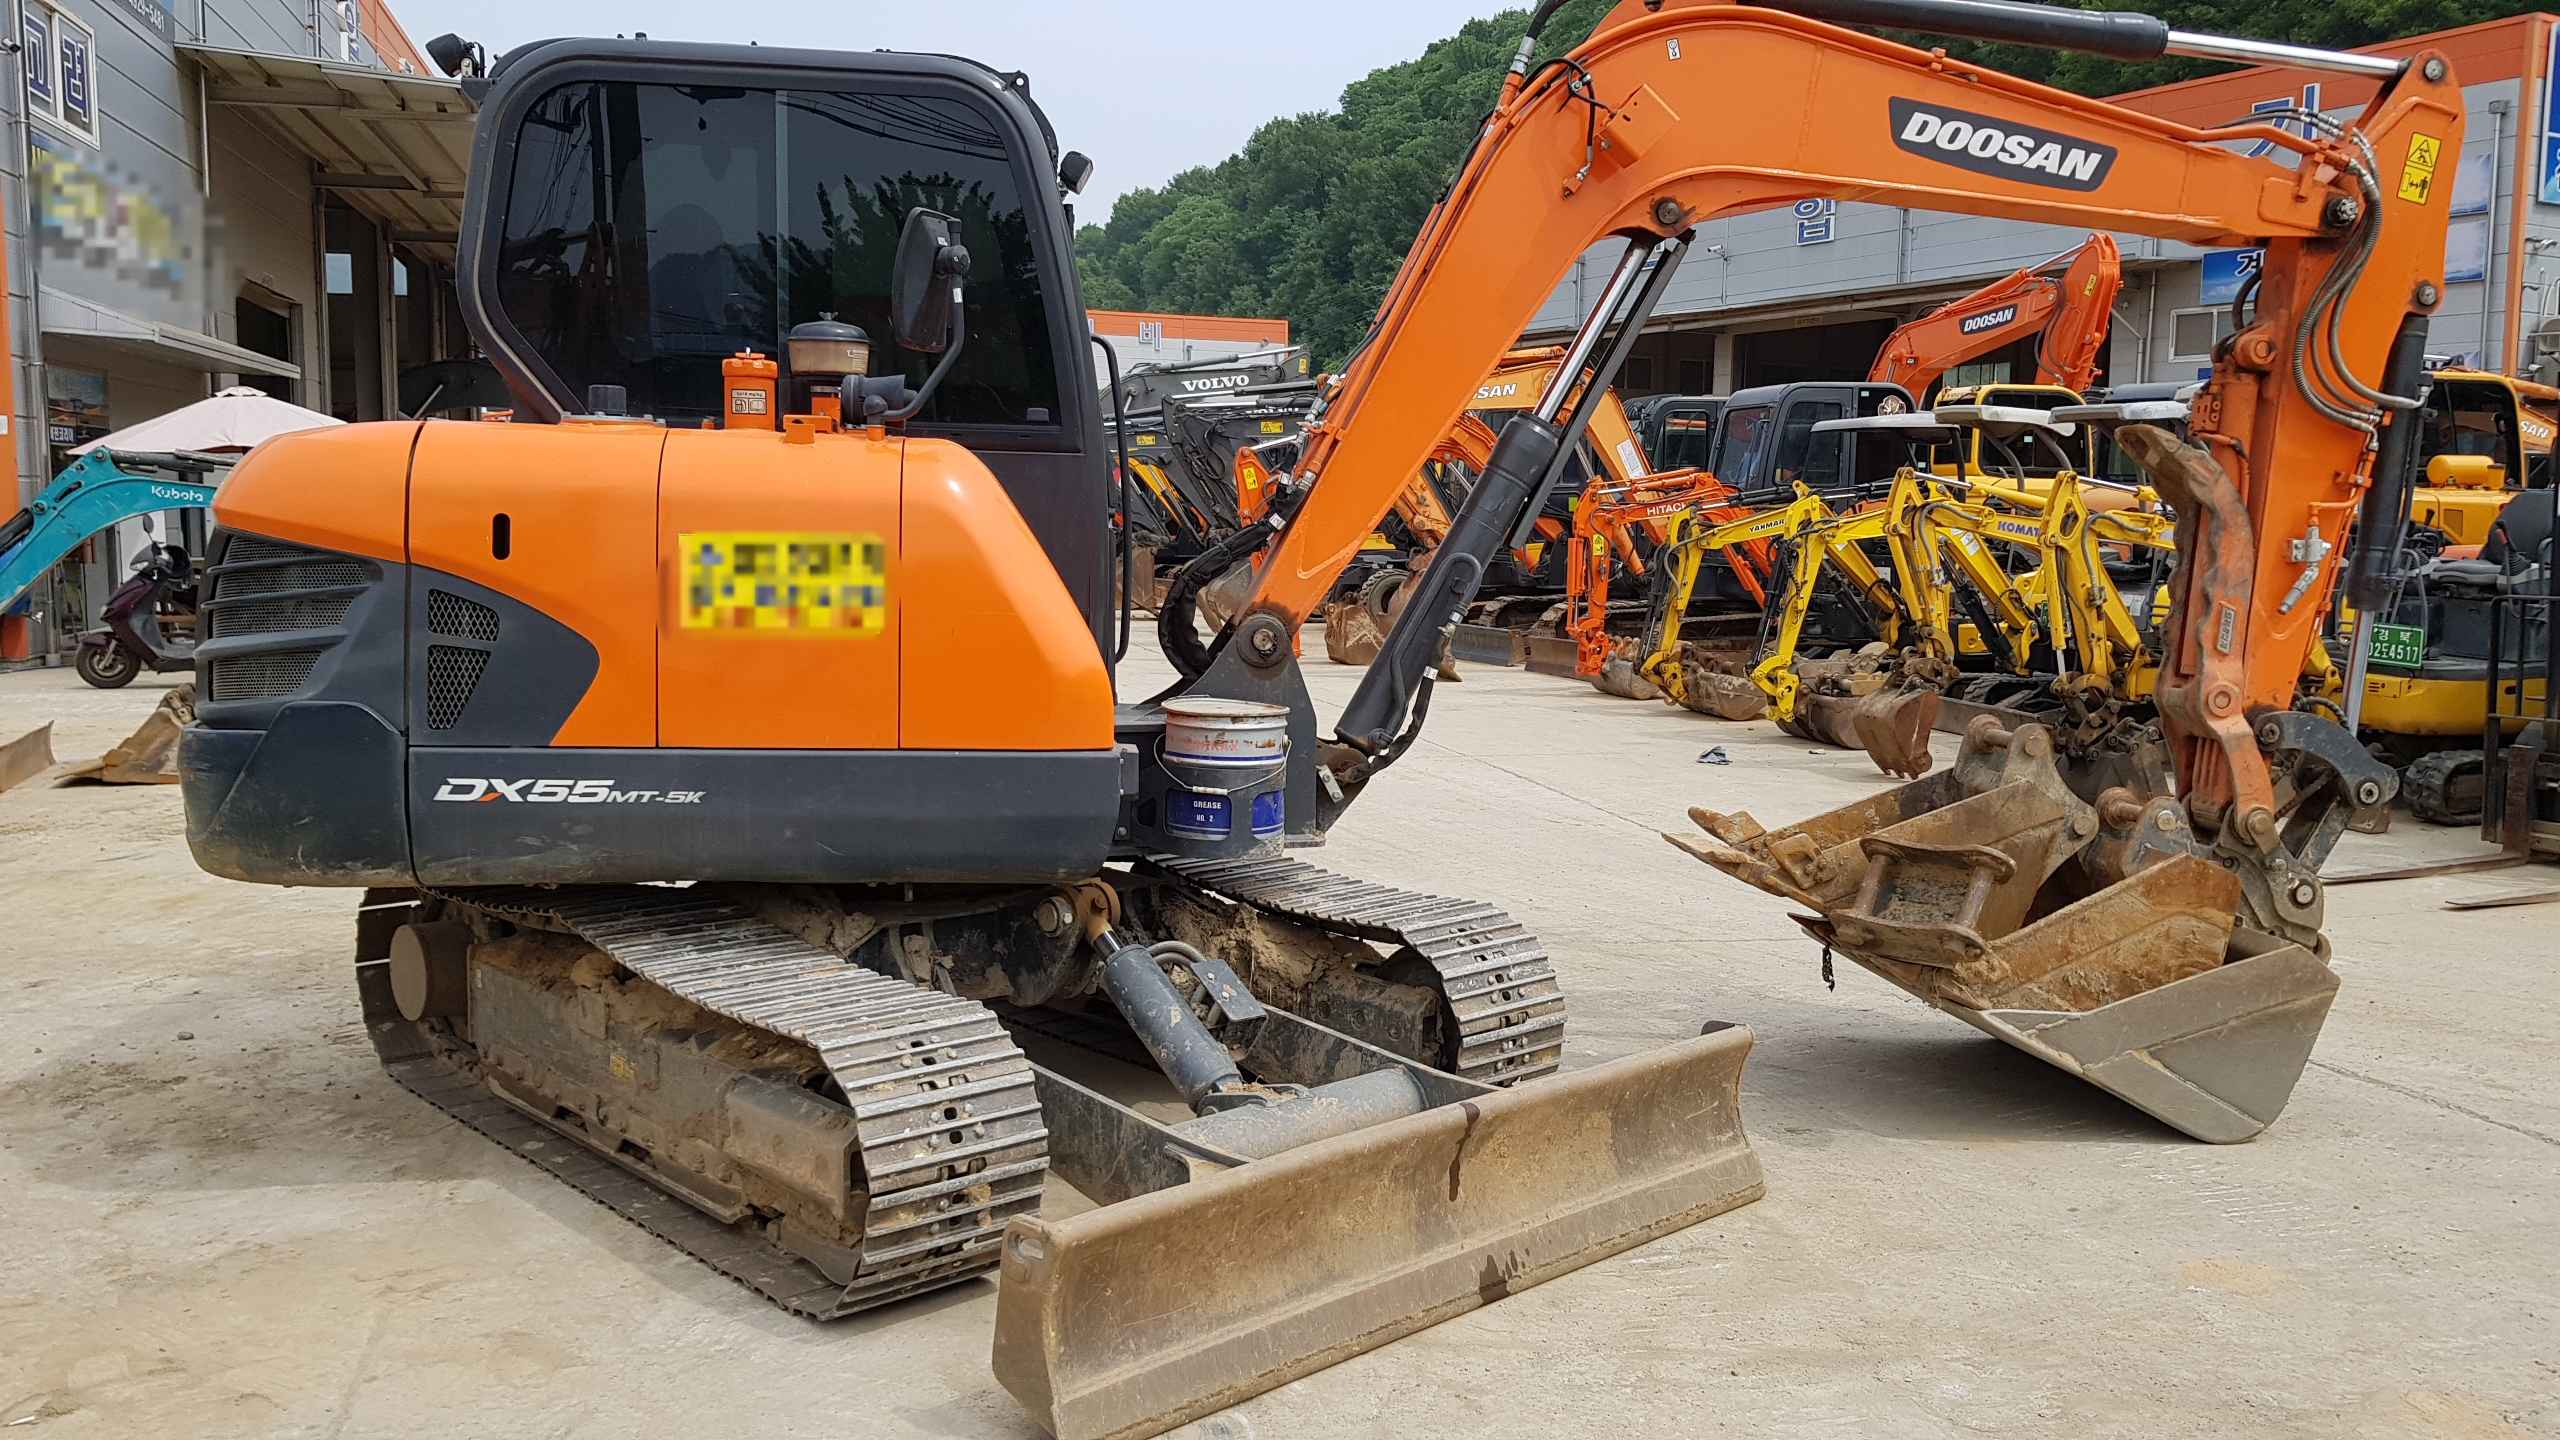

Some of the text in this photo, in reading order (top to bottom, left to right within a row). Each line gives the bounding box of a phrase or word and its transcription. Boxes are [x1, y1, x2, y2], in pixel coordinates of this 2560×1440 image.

[1901, 111, 2102, 182] DOOSAN
[1963, 307, 2014, 332] DOOSAN
[1181, 374, 1249, 392] VOLVO
[151, 485, 203, 502] Kubota
[1193, 800, 1222, 810] GREASE
